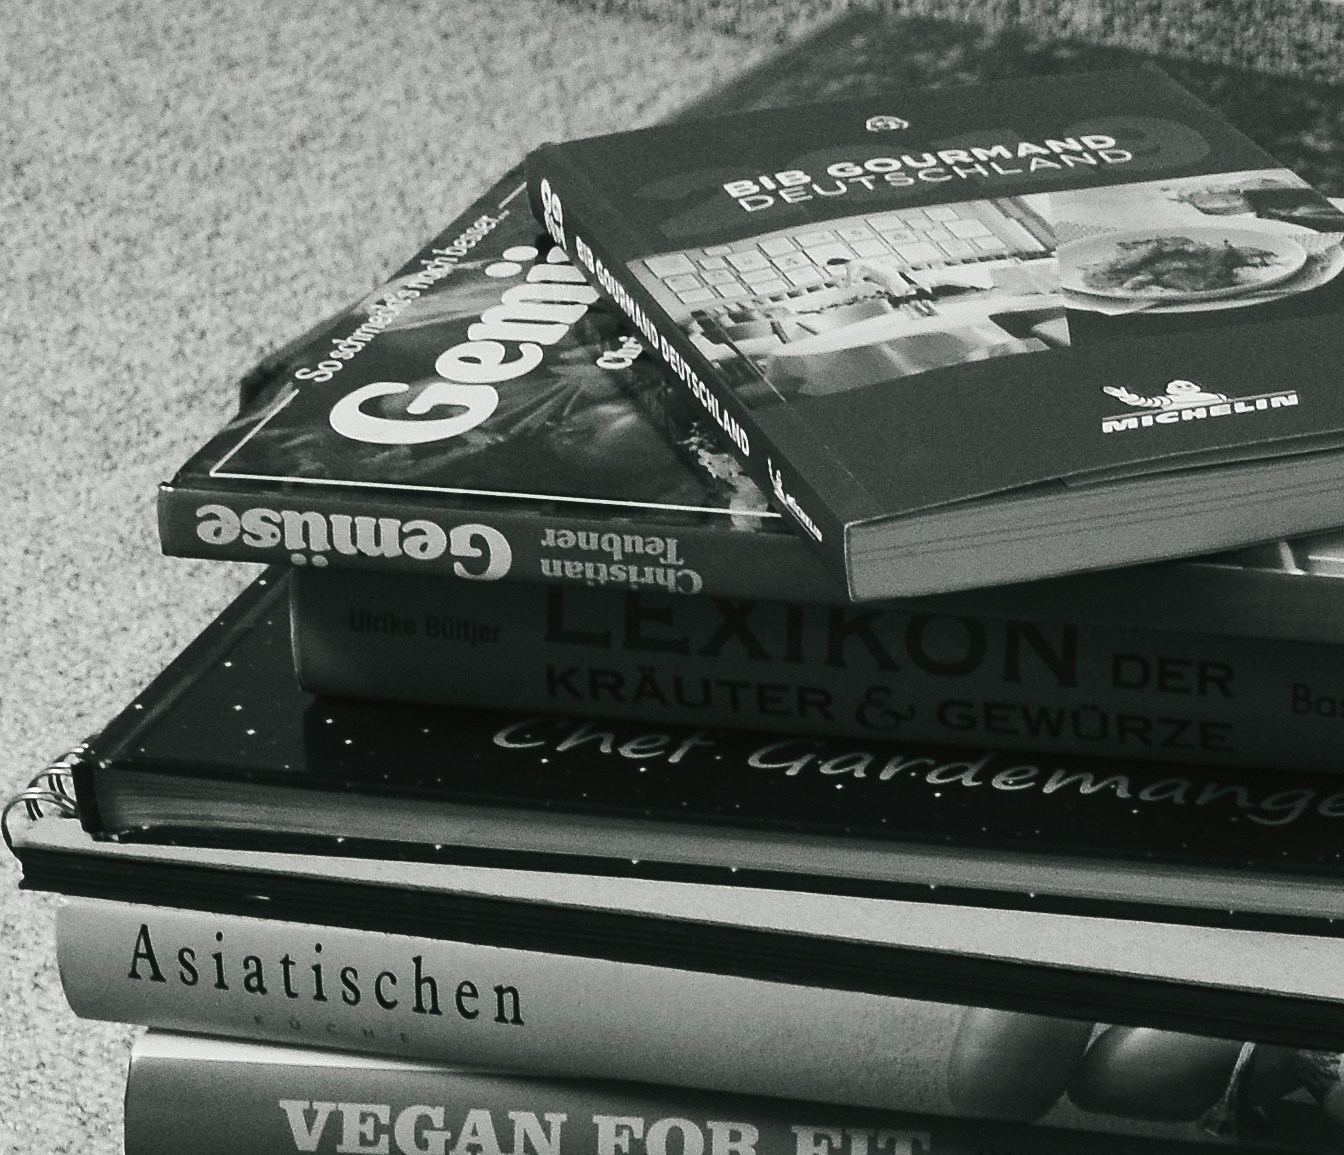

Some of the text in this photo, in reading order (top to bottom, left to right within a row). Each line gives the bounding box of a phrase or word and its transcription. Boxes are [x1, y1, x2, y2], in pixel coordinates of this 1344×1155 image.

[723, 133, 1117, 199] BIB GOURMAND
[737, 147, 1134, 212] DEUTSCHLAND
[295, 360, 343, 382] So
[329, 246, 600, 444] Gemü
[596, 258, 660, 349] GOURMAND
[660, 334, 750, 457] DEUTSCHLAND
[1101, 391, 1299, 432] MICHELIN
[196, 503, 514, 582] Gemüse
[540, 528, 684, 566] Teubner
[539, 556, 704, 596] Christian
[348, 607, 501, 646] Ulrike Bültjer
[545, 585, 1236, 698] LEXIKON DER
[492, 717, 715, 763] Chef
[543, 662, 1235, 754] KRÄUTER & GEWÜRZE
[127, 923, 526, 1027] Asiatischen
